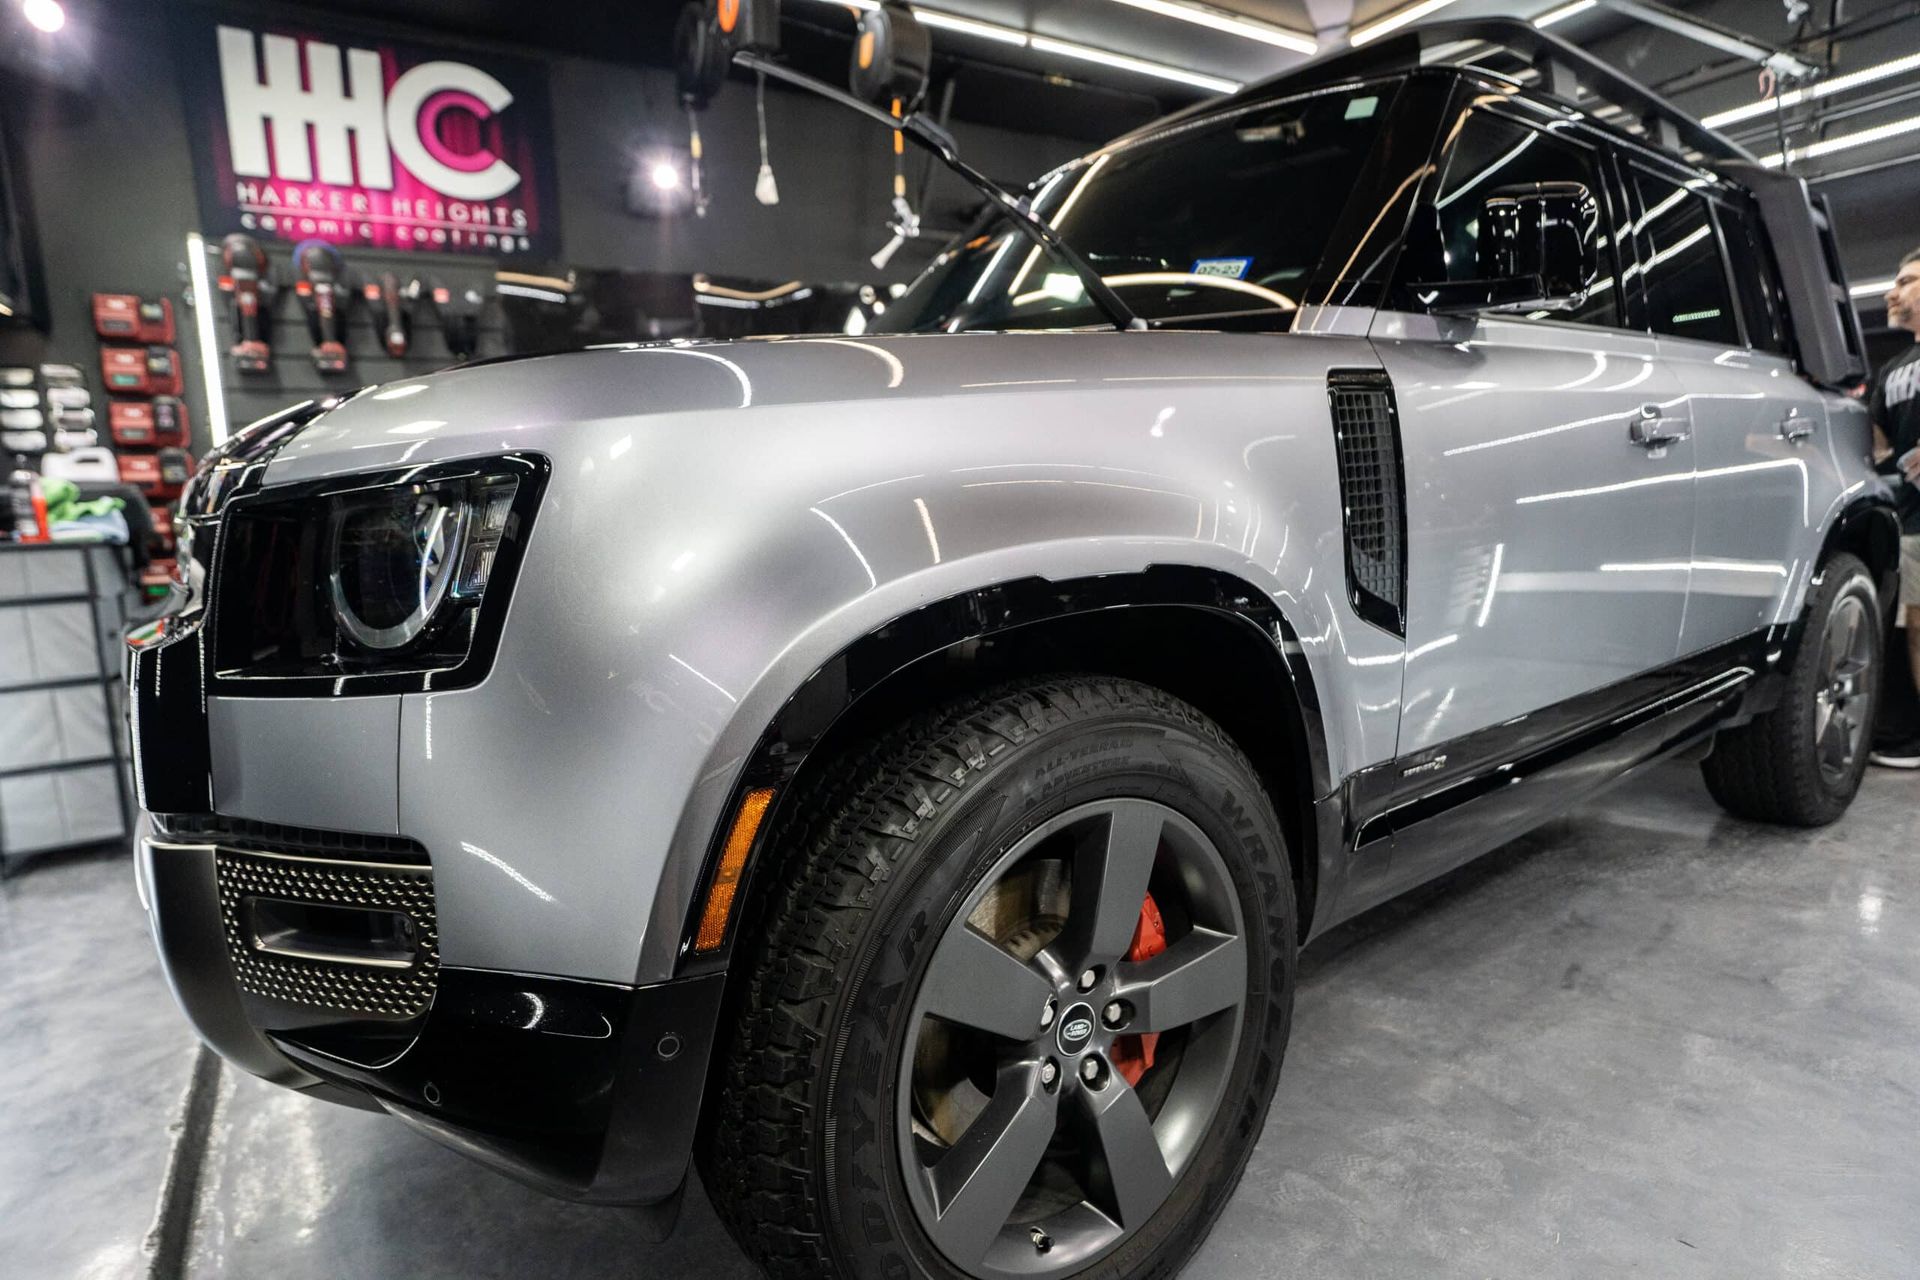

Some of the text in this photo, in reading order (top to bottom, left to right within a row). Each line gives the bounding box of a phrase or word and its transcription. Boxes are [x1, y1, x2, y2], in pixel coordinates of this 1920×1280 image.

[236, 181, 528, 228] HARKER HEIGHTS
[240, 213, 530, 253] ceramic coatings
